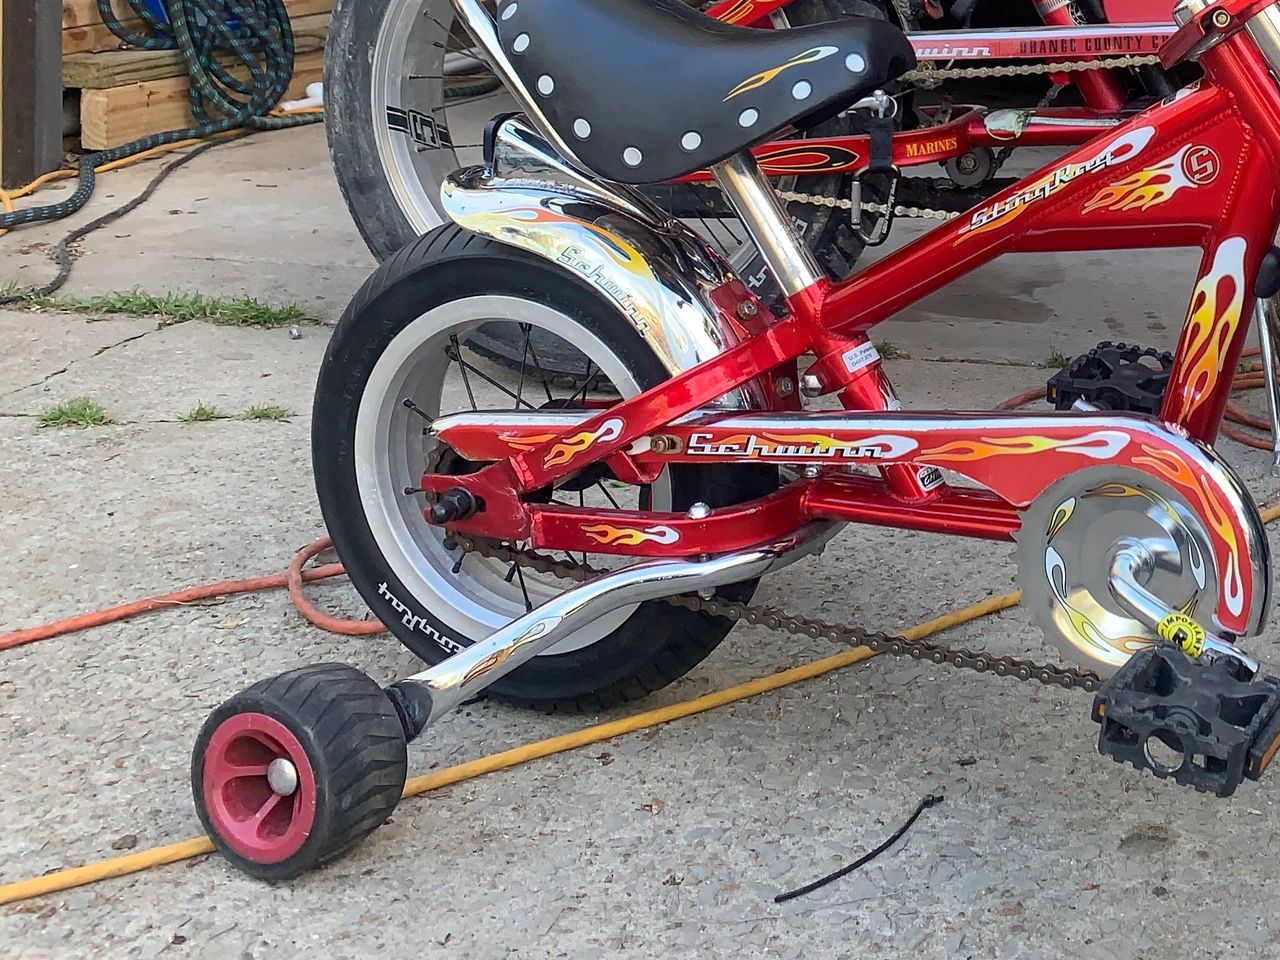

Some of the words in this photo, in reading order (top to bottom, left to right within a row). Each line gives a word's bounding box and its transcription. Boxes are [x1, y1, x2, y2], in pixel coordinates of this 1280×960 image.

[916, 43, 991, 57] winn
[1085, 36, 1144, 52] COUNTY
[905, 137, 958, 158] MARINES
[556, 245, 652, 337] Schwinn
[687, 433, 886, 459] Schwinn
[1163, 615, 1202, 651] IMPORTANT
